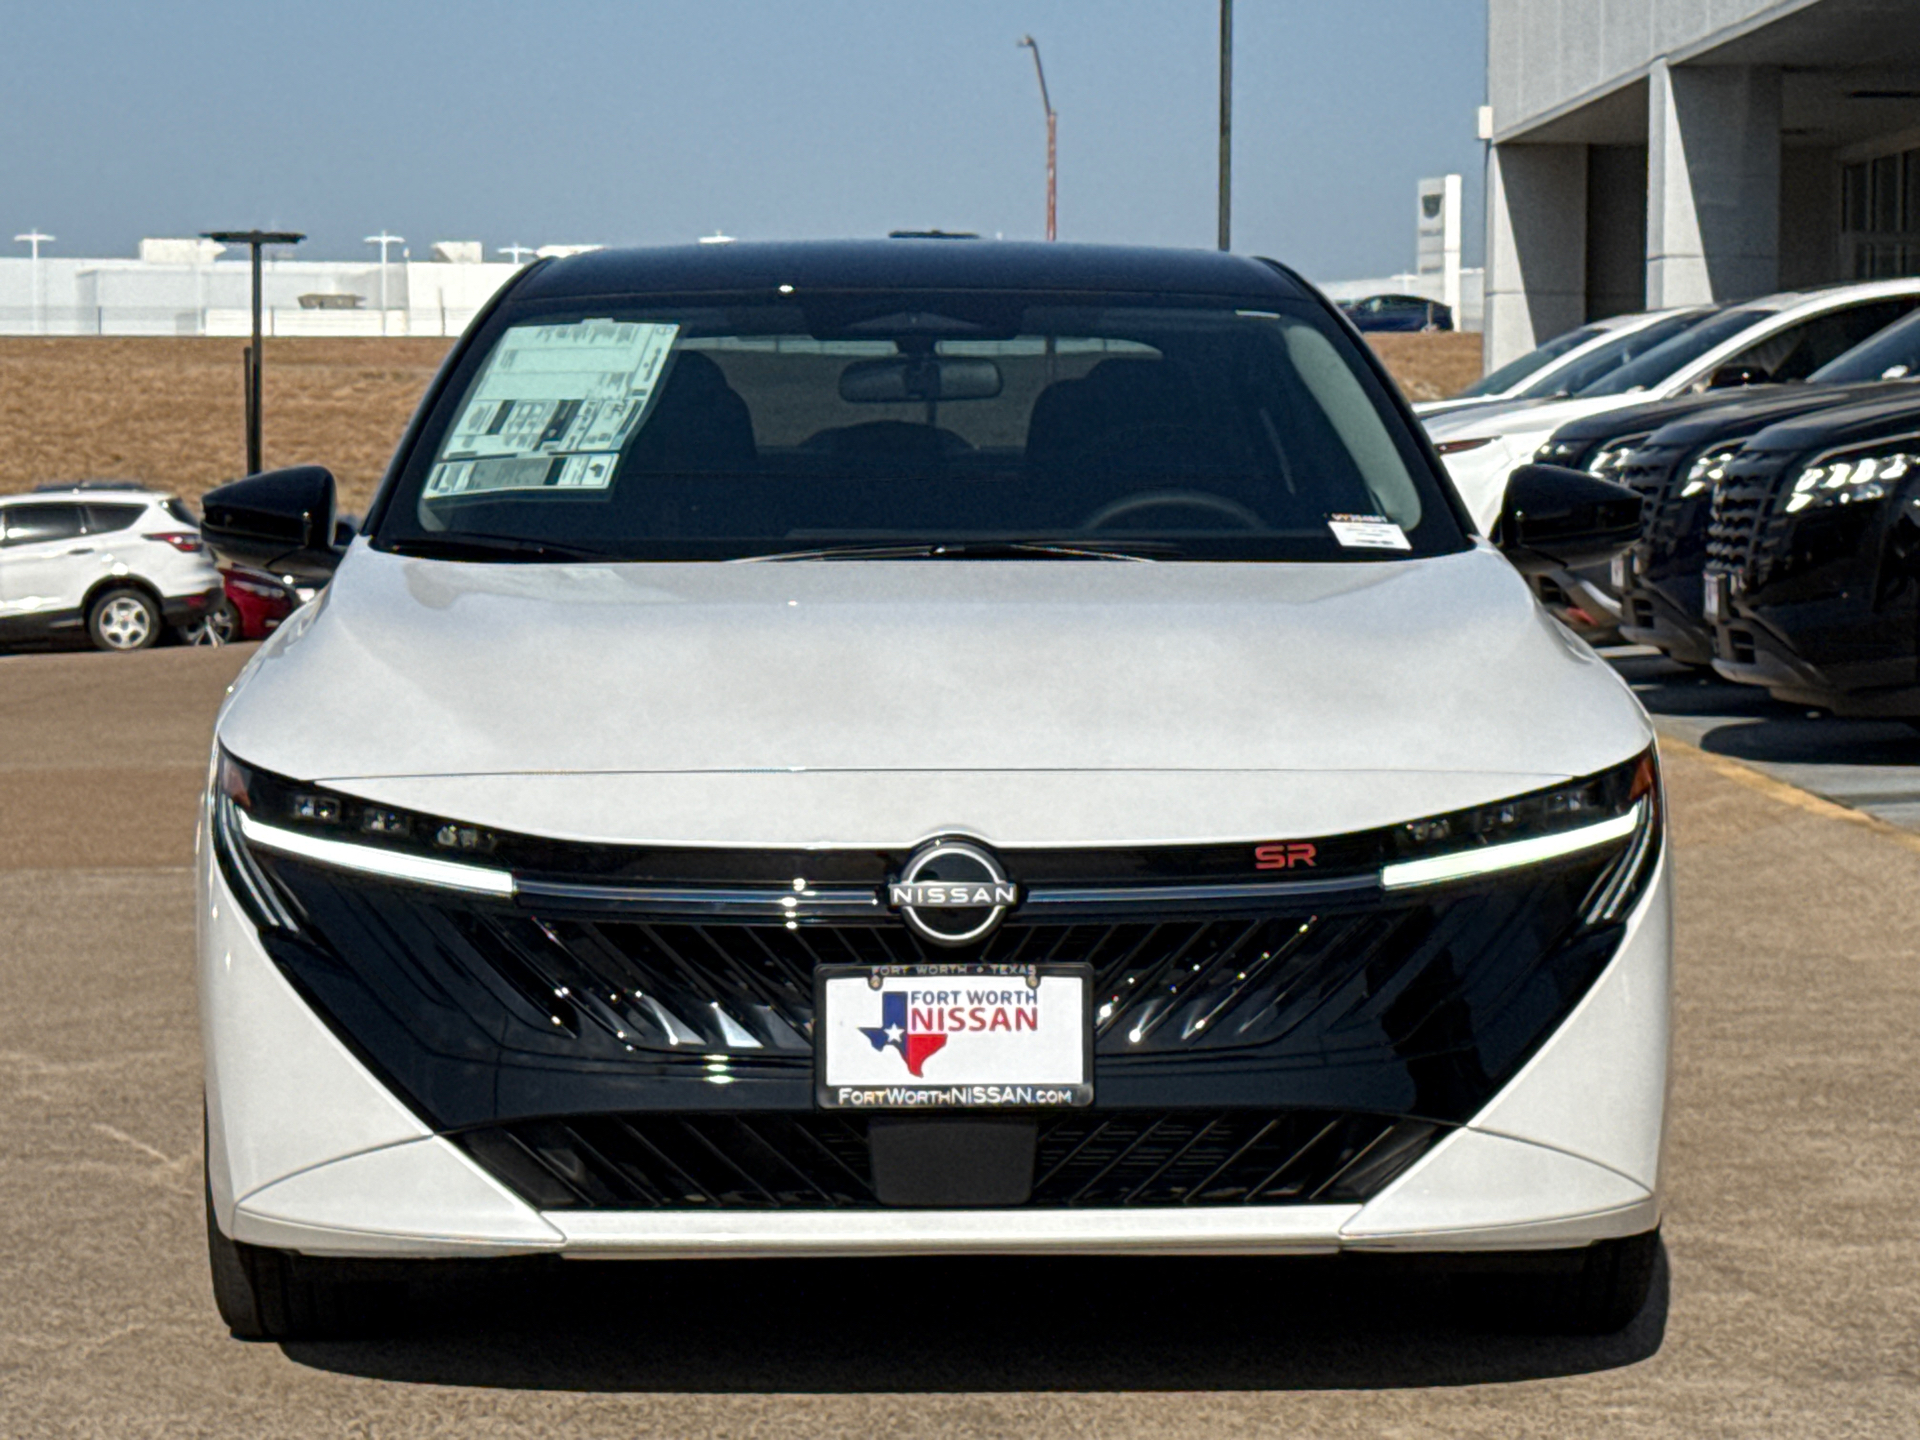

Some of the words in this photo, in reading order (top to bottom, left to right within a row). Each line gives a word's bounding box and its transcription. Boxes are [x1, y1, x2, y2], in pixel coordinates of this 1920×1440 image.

[1254, 844, 1317, 870] SR
[892, 886, 1015, 904] NISSAN
[872, 966, 908, 976] FORT
[915, 965, 968, 975] WORTH
[990, 965, 1037, 975] TEXAS
[911, 990, 962, 1006] FORT
[967, 990, 1038, 1006] WORTH
[911, 1007, 1038, 1032] NISSAN
